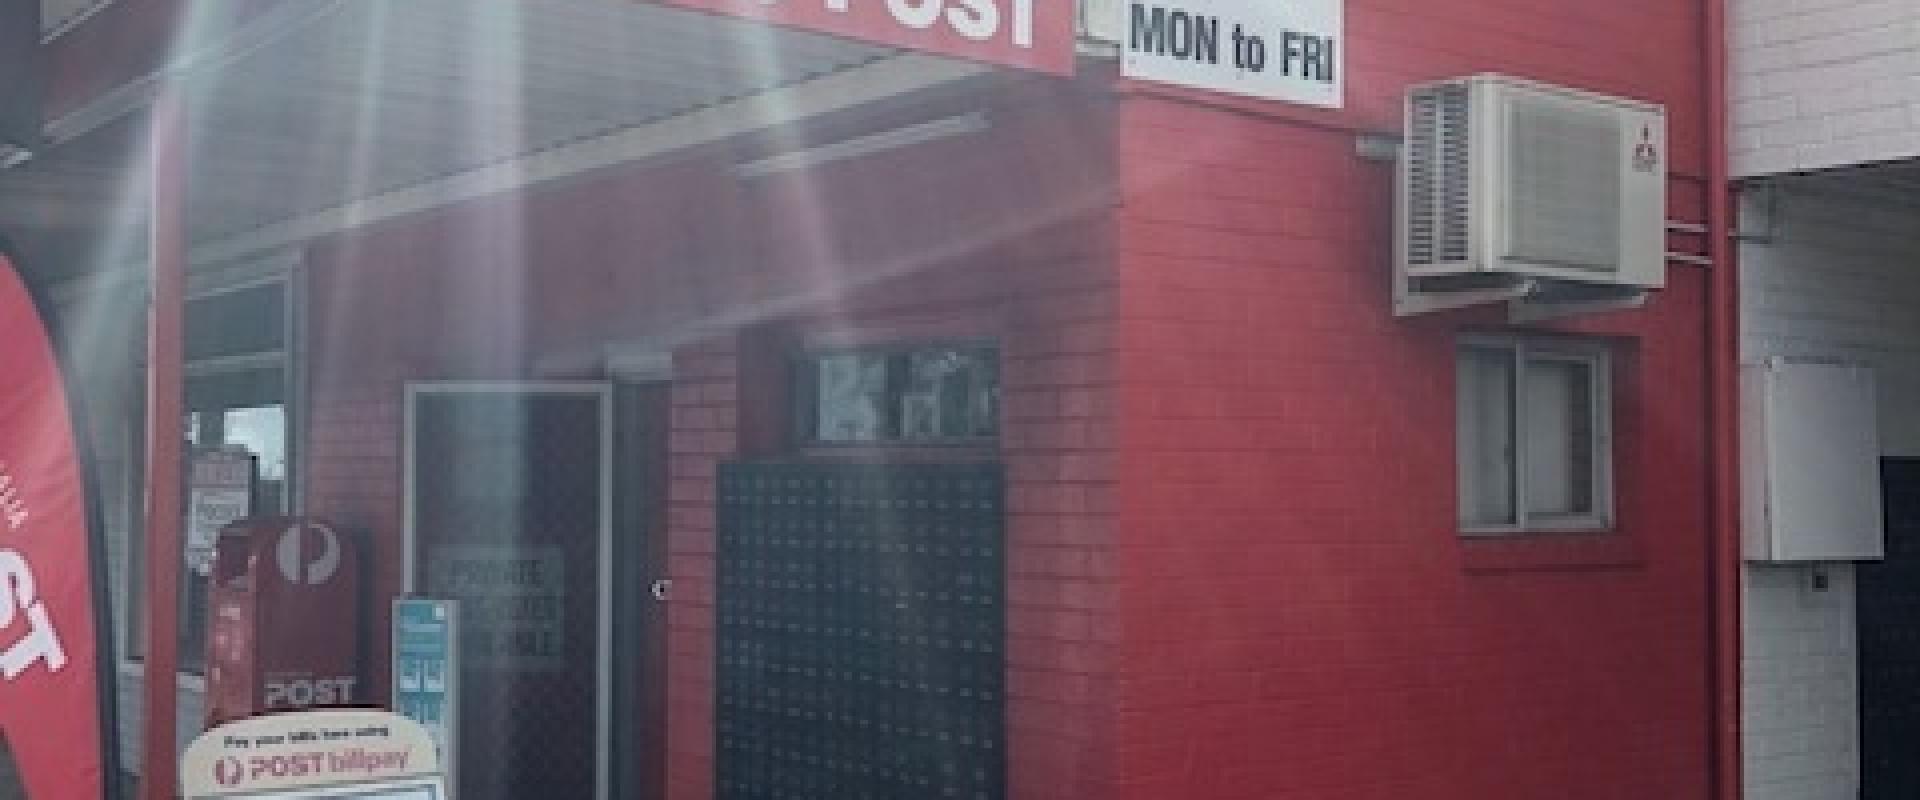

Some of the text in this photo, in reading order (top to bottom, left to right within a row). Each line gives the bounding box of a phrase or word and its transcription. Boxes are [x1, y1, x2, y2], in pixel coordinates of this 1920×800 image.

[1129, 4, 1336, 83] MON to FRI
[265, 677, 355, 705] POST
[249, 752, 324, 780] POST
